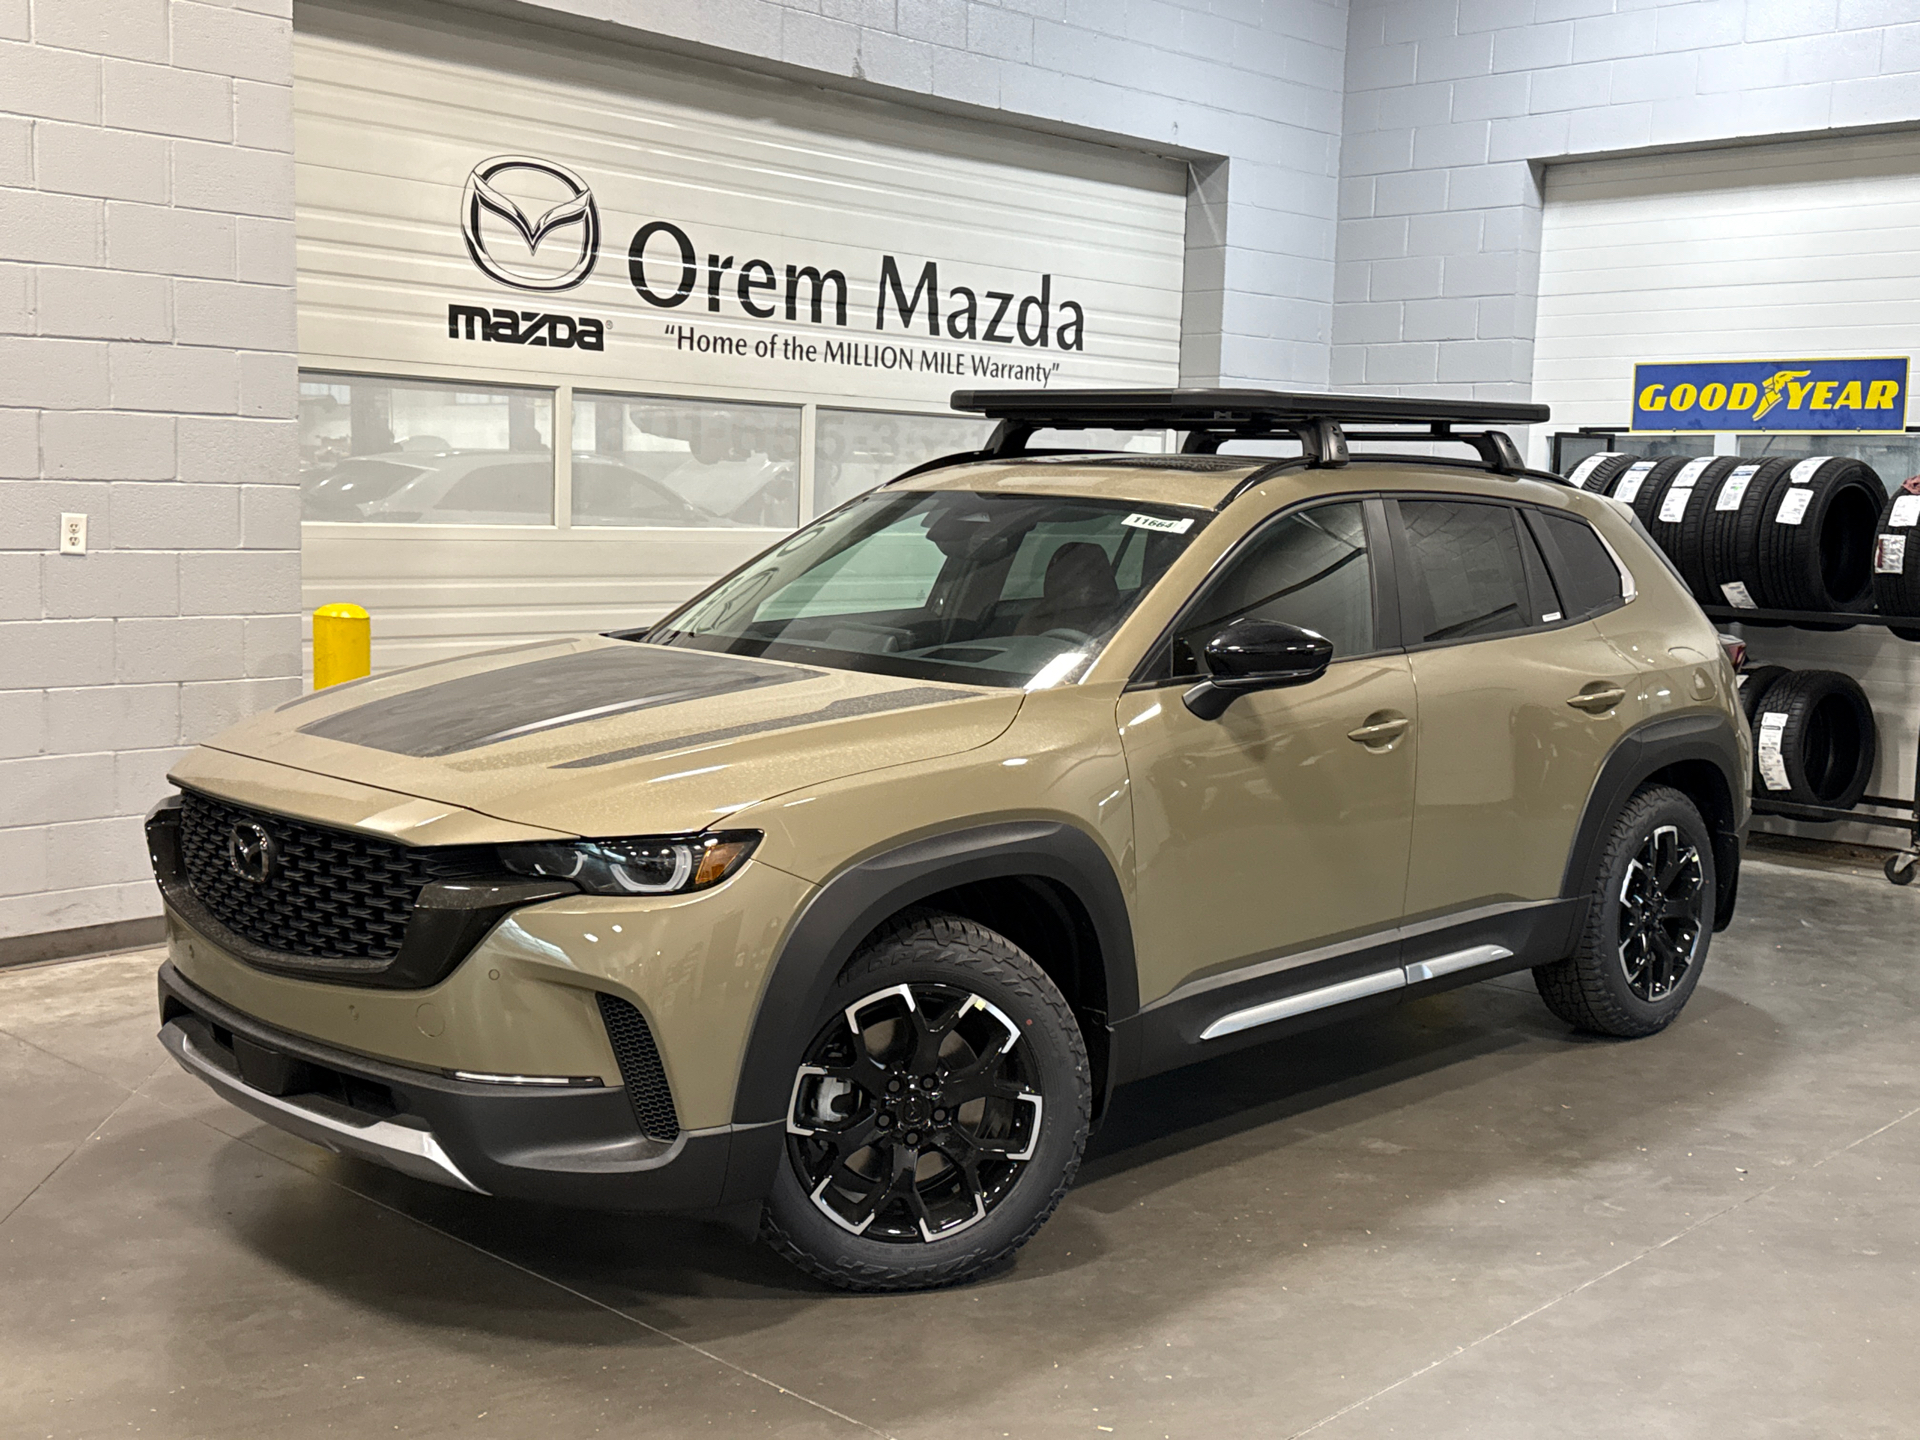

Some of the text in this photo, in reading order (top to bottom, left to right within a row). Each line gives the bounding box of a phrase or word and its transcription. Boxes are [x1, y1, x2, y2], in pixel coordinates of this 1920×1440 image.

[628, 221, 1084, 352] Orem Mazda
[755, 333, 778, 359] of
[783, 336, 817, 362] the
[824, 340, 913, 371] MILLION
[919, 350, 965, 376] MILE
